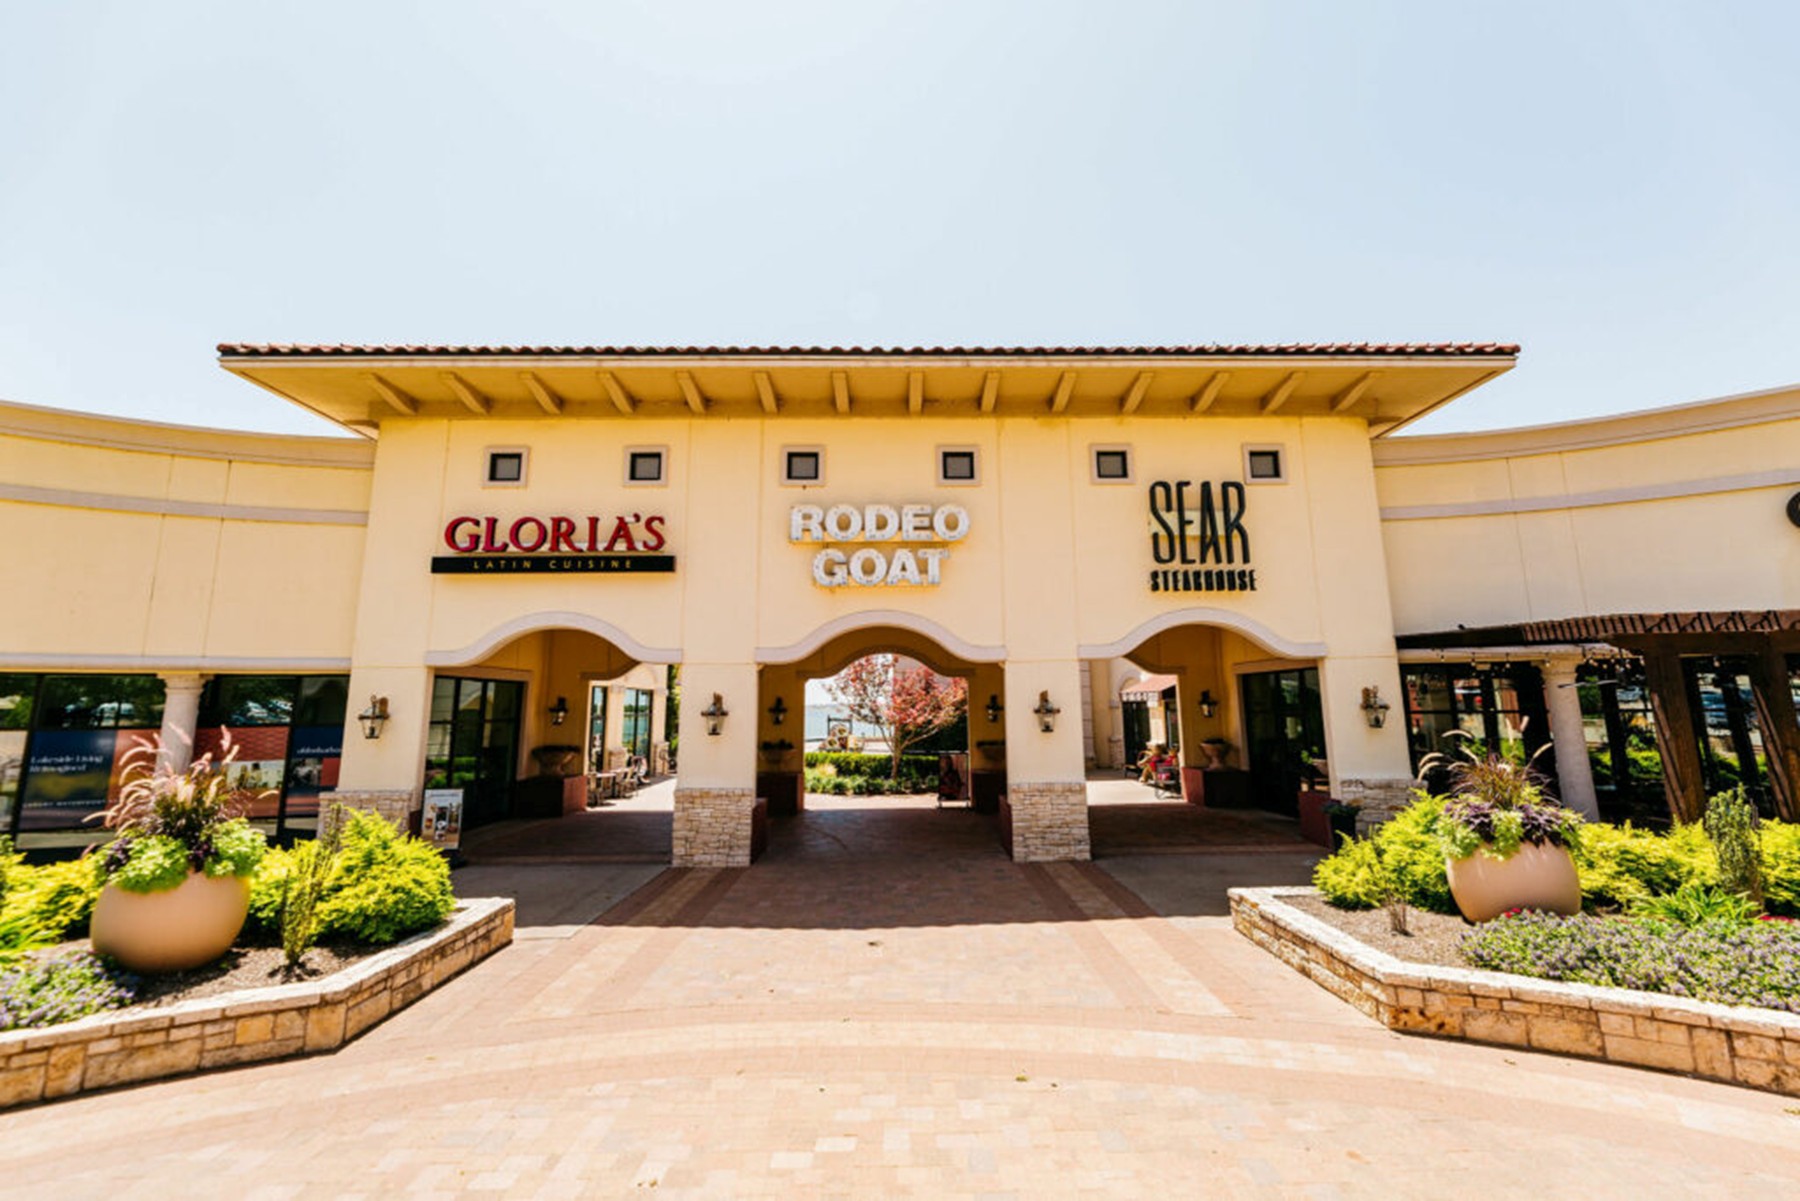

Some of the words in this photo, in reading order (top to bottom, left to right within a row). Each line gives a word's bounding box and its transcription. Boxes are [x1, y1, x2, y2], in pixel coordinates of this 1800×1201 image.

[445, 513, 666, 553] GLORIA'S
[789, 504, 970, 541] RODEO
[1149, 480, 1250, 564] SEAR
[473, 560, 532, 569] LATIN
[549, 559, 632, 569] CUISINE
[812, 548, 949, 586] GOAT
[1150, 569, 1257, 591] STEAKHOUSE
